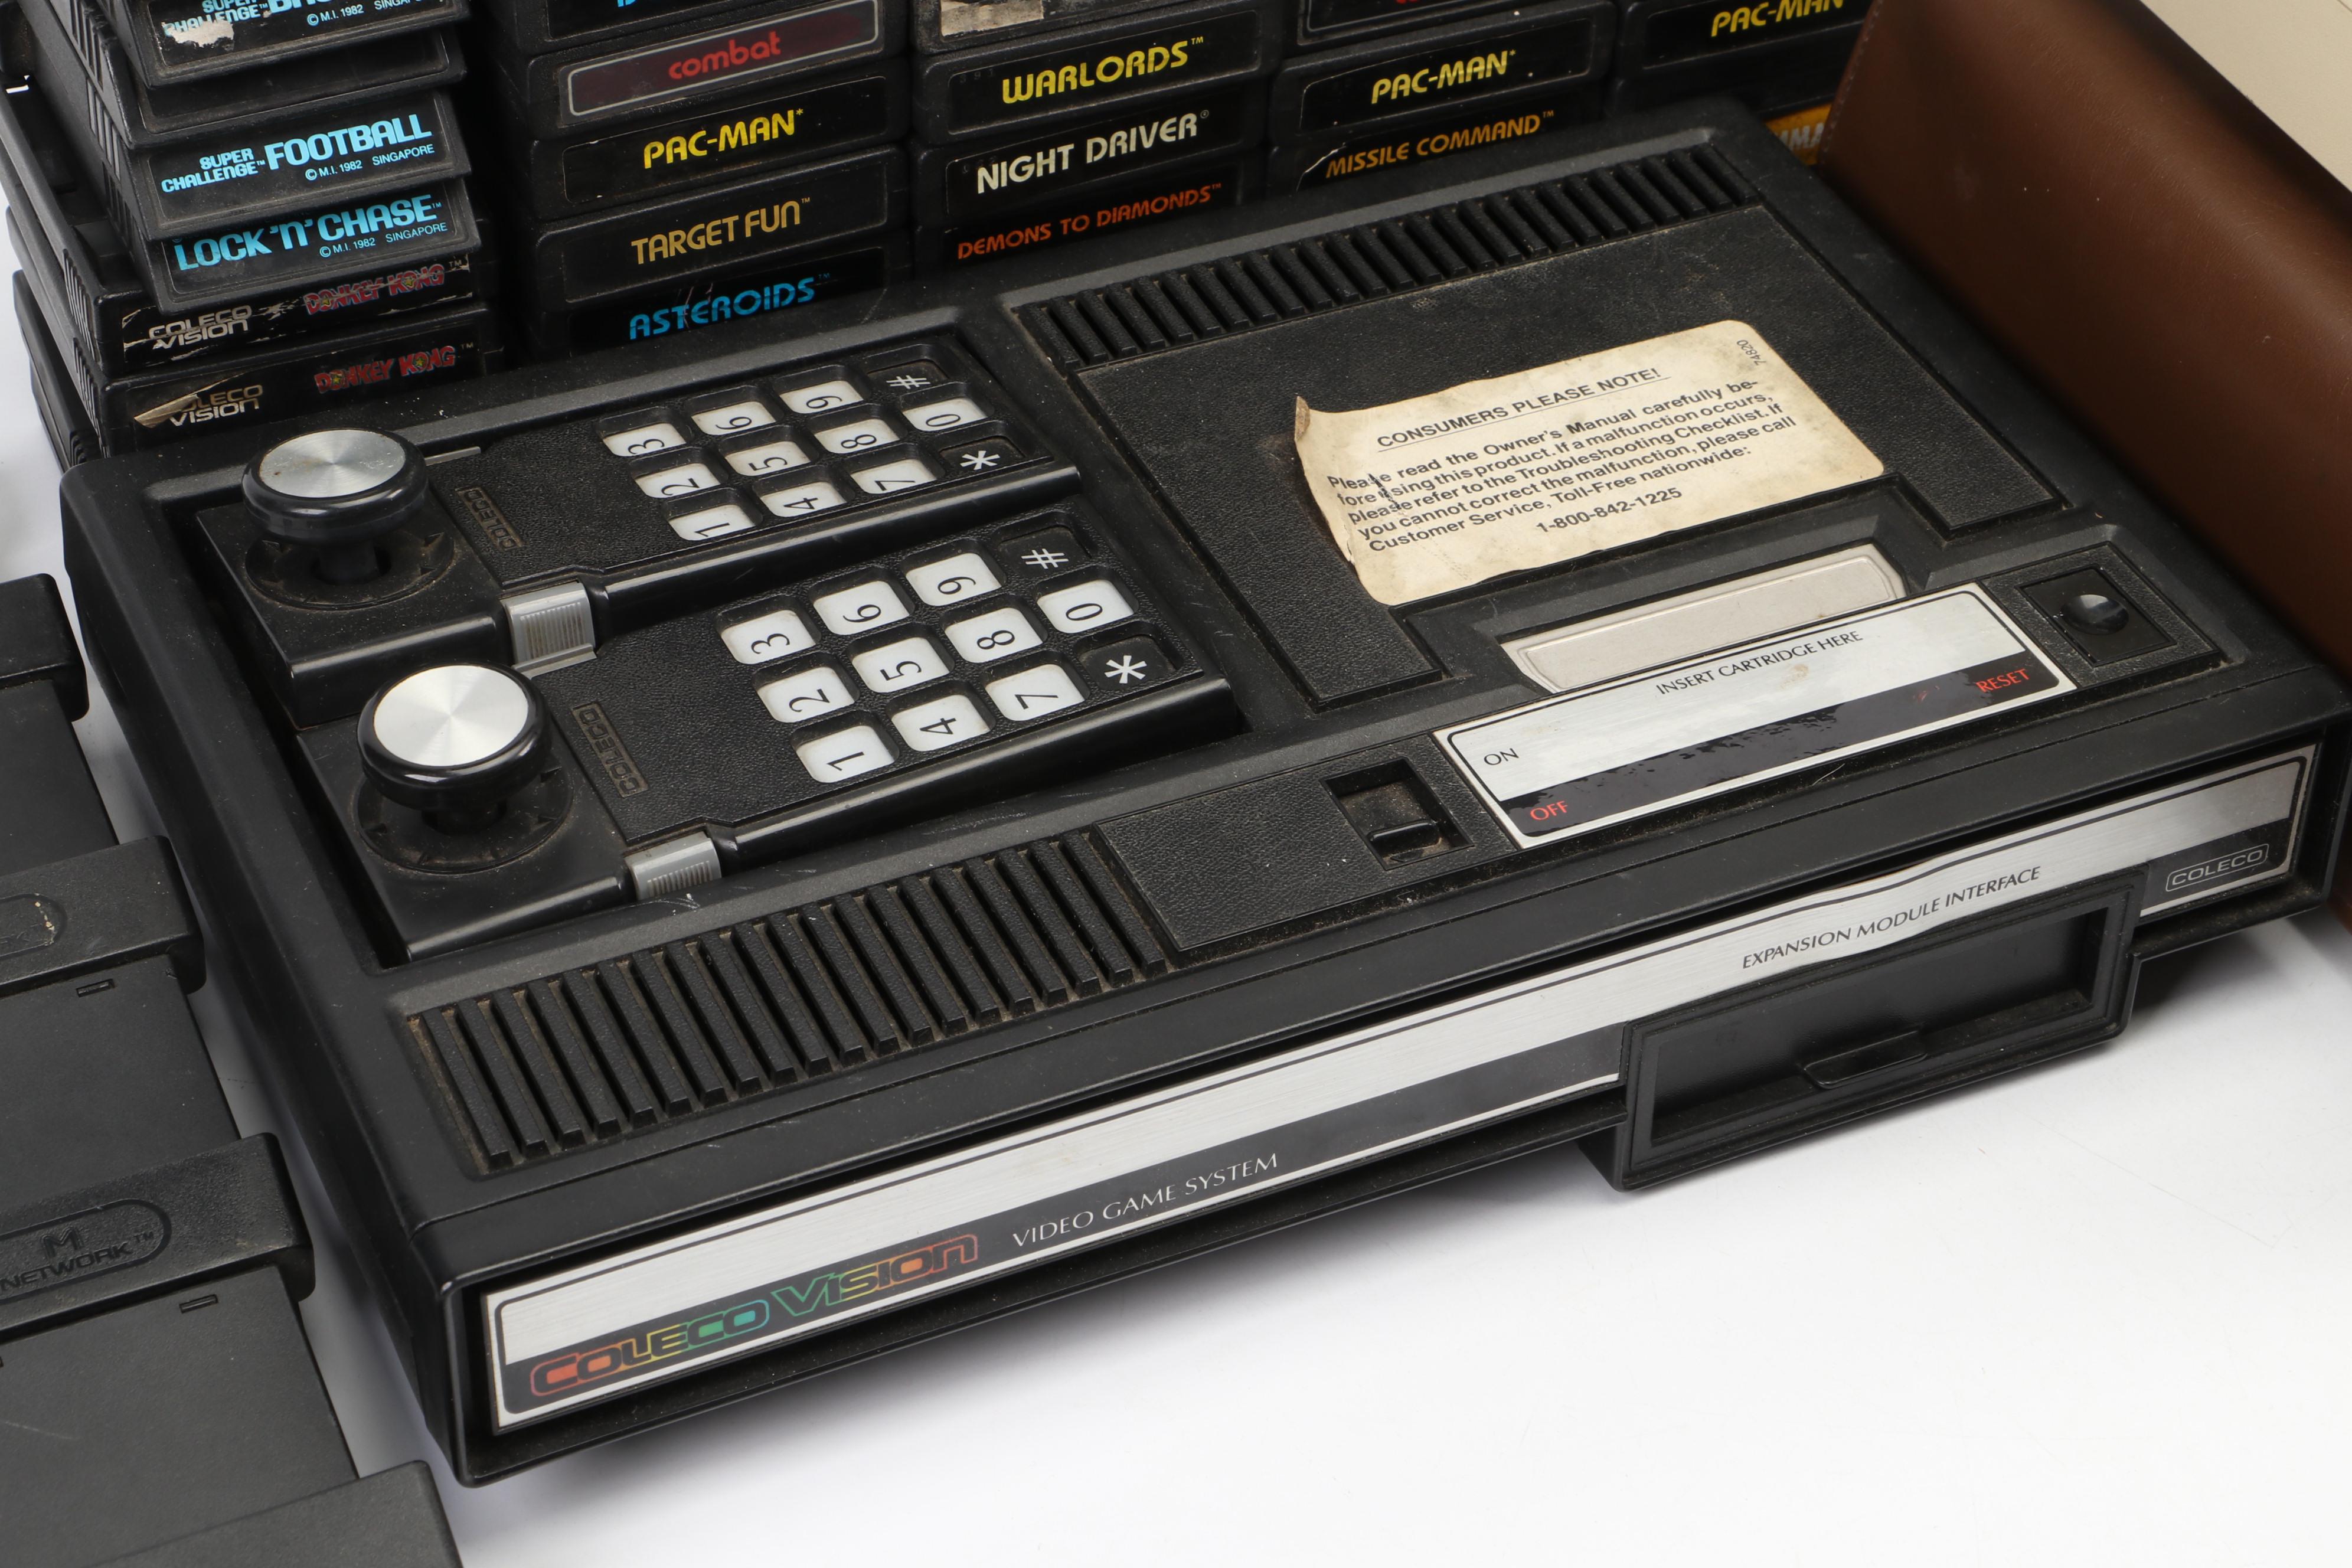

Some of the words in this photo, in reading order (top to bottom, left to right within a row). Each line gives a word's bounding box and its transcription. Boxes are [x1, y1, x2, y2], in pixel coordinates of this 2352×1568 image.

[340, 4, 364, 17] 1982
[668, 31, 781, 80] combat
[199, 148, 254, 169] SUPER
[264, 113, 432, 171] FOOTBALL
[339, 159, 362, 172] 1982
[372, 143, 435, 166] SINGAPORE
[1325, 141, 1410, 179] MISSILE
[976, 143, 1074, 194] NIGHT
[354, 237, 376, 250] 1982
[386, 223, 447, 243] SINGAPORE
[631, 215, 739, 265] TARGET
[958, 223, 1051, 260] DEMONS
[1061, 214, 1090, 235] TO
[303, 277, 383, 315] DONKEY
[387, 264, 444, 295] KONG
[149, 305, 252, 339] COLECO
[152, 319, 248, 349] VISION
[315, 358, 395, 393] DONKEY
[398, 346, 455, 376] KONG
[1737, 339, 1767, 365] 74820
[169, 398, 259, 426] VISION
[925, 413, 961, 430] 0
[1377, 406, 1509, 448] CONSUMERS
[1513, 385, 1595, 413] PLEASE
[1598, 367, 1661, 394] NOTE!
[628, 438, 665, 454] 3
[715, 415, 752, 433] 6
[1327, 473, 1392, 489] Please
[1397, 459, 1442, 478] read
[1445, 452, 1479, 465] the
[1483, 430, 1562, 456] Owner's
[1566, 409, 1637, 435] Manual
[1642, 386, 1723, 415] carefully
[1726, 379, 1759, 394] be-
[1337, 492, 1377, 506] fore
[1434, 468, 1474, 484] this
[1473, 447, 1556, 478] product.
[1555, 441, 1569, 454] If
[1572, 440, 1585, 450] a
[1586, 411, 1699, 446] malfunction
[1700, 393, 1773, 416] occurs,
[661, 477, 698, 496] 2
[748, 456, 788, 473] 5
[840, 434, 876, 450] 8
[1348, 501, 1413, 525] please
[1414, 489, 1459, 507] refer
[1462, 484, 1484, 494] to
[1483, 474, 1517, 489] the
[1515, 433, 1676, 480] Troubleshooting
[1674, 411, 1769, 439] Checklist.
[1768, 403, 1783, 415] If
[1357, 521, 1397, 541] you
[1399, 502, 1470, 527] cannot
[1469, 484, 1541, 509] correct
[1541, 475, 1575, 491] the
[1575, 443, 1697, 482] malfunction,
[1696, 426, 1760, 452] please
[1762, 416, 1797, 433] call
[463, 490, 517, 550] COLECO
[695, 521, 730, 536] 1
[782, 496, 819, 512] 4
[874, 478, 916, 491] 7
[1369, 519, 1465, 552] Customer
[1468, 499, 1552, 525] Service,
[1550, 476, 1637, 505] Toll-Free
[1639, 444, 1752, 483] nationwide:
[1535, 487, 1683, 534] 1-800-842-1225
[751, 632, 790, 655] 3
[842, 603, 881, 625] 6
[937, 576, 976, 596] 9
[1065, 603, 1103, 621] 0
[789, 688, 830, 713] 2
[884, 661, 922, 682] 5
[976, 629, 1016, 651] 8
[1655, 665, 1717, 697] INSERT
[1718, 641, 1818, 678] CARTRIDGE
[1816, 629, 1864, 651] HERE
[1975, 667, 2031, 695] RESET
[579, 708, 639, 794] COLECO
[827, 749, 867, 771] 1
[919, 718, 958, 736] 4
[1014, 692, 1058, 709] 7
[1482, 747, 1521, 767] ON
[1529, 798, 1569, 822] OFF
[2170, 850, 2263, 888] COLECO
[1742, 927, 1852, 969] EXPANSION
[1856, 898, 1942, 937] MODULE
[1945, 866, 2042, 907] INTERFACE
[1012, 1211, 1094, 1247] VIDEO
[1102, 1184, 1177, 1220] GAME
[1184, 1152, 1279, 1195] SYSTEM
